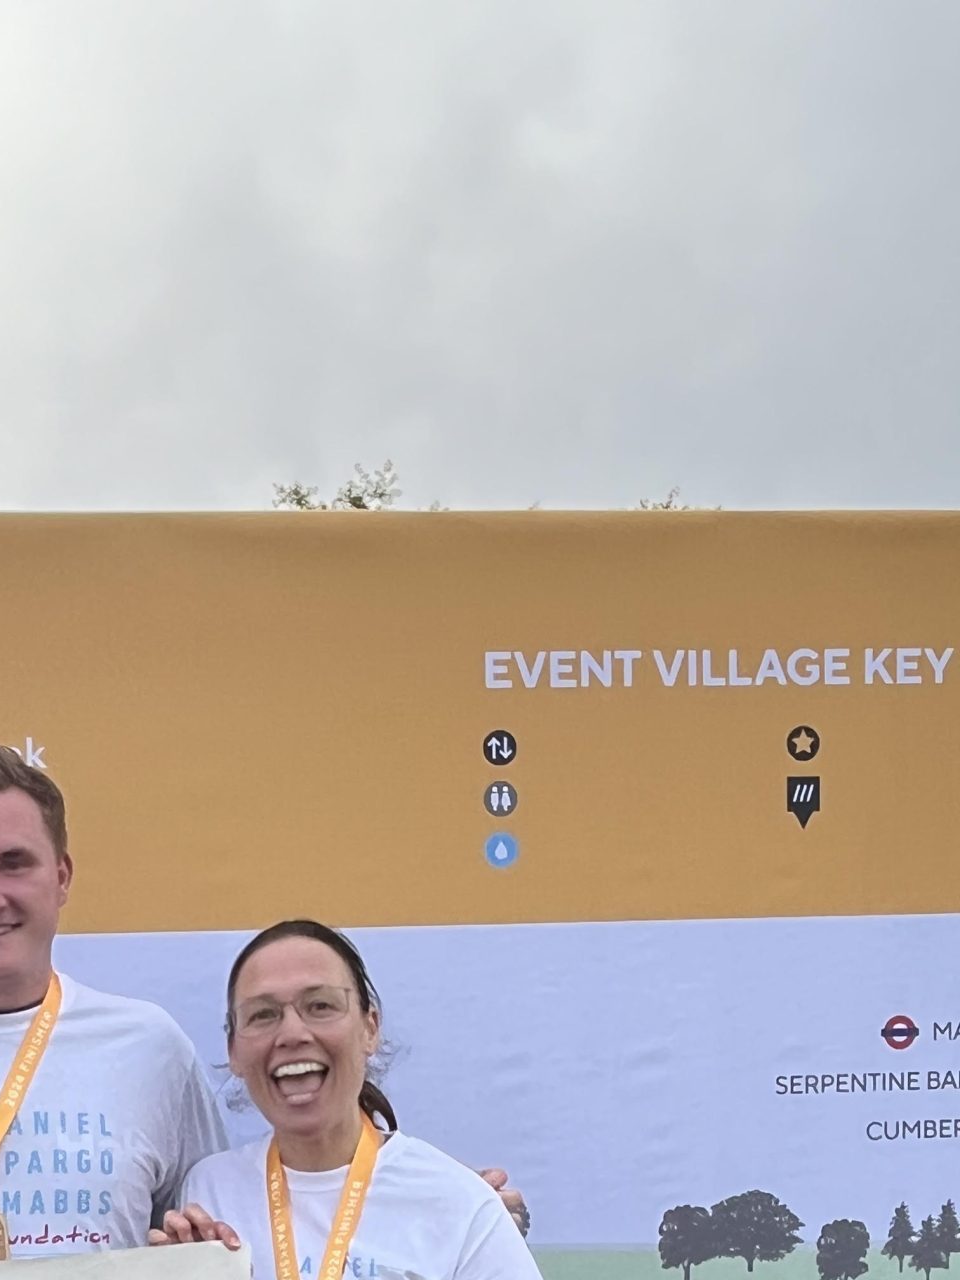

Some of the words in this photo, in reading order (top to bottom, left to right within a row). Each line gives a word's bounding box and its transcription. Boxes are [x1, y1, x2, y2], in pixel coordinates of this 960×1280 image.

[485, 650, 642, 688] EVENT
[653, 648, 850, 686] VILLAGE
[864, 648, 954, 684] KEY
[19, 1010, 53, 1072] FINISHER
[775, 1072, 920, 1095] SERPENTINE
[927, 1069, 960, 1090] BA
[5, 1149, 114, 1176] PARGO
[2, 1190, 112, 1215] MABBS
[335, 1181, 364, 1245] FINISHER
[8, 1224, 110, 1245] undation
